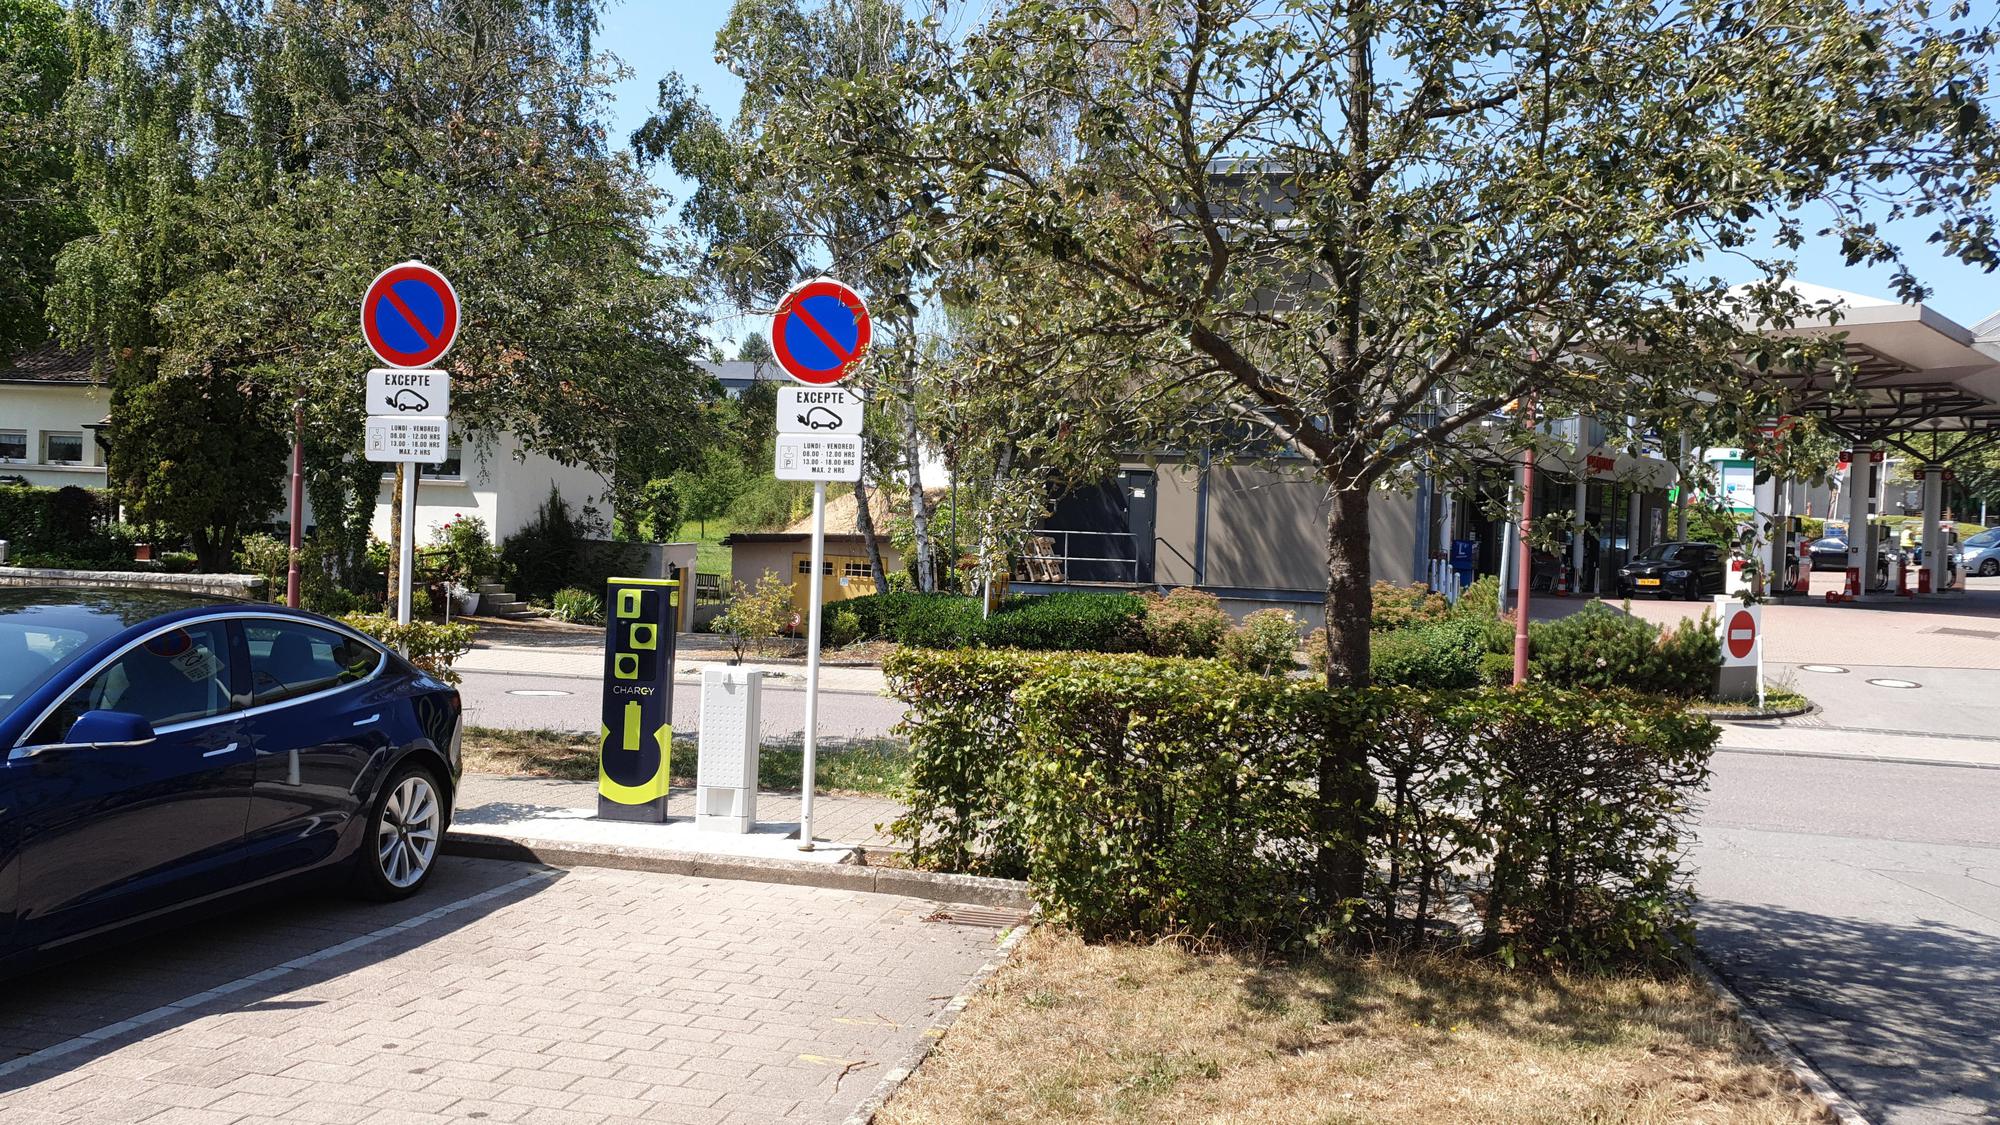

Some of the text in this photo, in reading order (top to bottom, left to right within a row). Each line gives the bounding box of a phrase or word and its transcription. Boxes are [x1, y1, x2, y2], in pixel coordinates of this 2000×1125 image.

[385, 374, 430, 386] EXCEPTE
[797, 392, 844, 404] EXCEPTE
[613, 686, 655, 696] CHARGY
